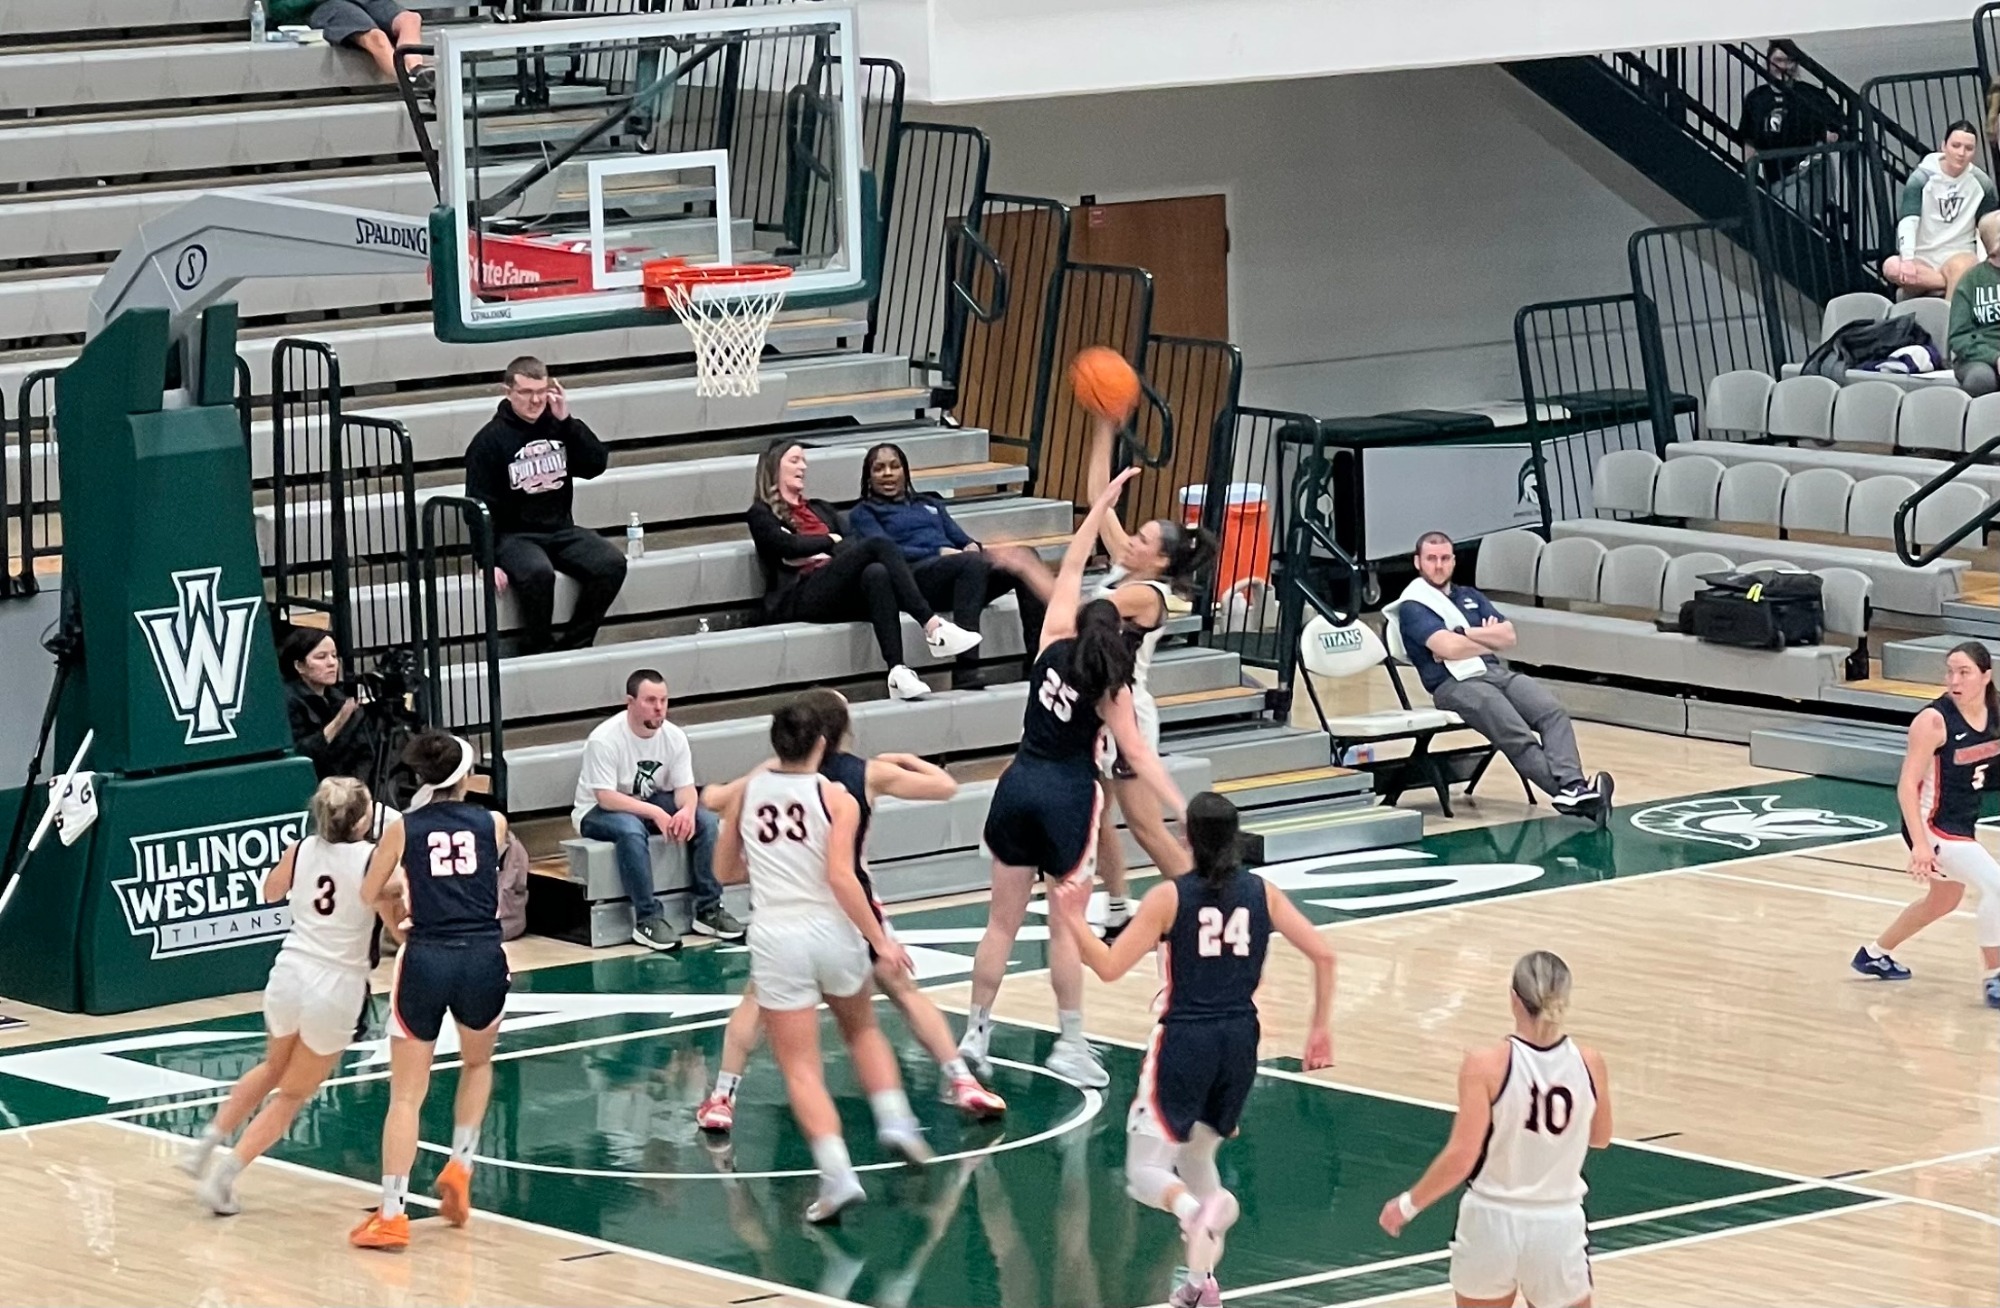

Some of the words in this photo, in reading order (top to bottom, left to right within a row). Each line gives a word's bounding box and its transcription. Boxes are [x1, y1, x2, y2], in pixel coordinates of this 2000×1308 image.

[356, 218, 428, 255] SPALDING
[471, 308, 512, 320] SPALDING
[1319, 629, 1362, 649] TITANS
[1039, 667, 1079, 722] 25
[1971, 764, 1989, 790] 5
[757, 803, 806, 843] 33
[144, 824, 297, 882] ILLINOIS
[427, 830, 477, 876] 23
[314, 875, 335, 916] 3
[172, 912, 282, 943] TITANS
[1198, 906, 1250, 957] 24
[1524, 1081, 1573, 1136] 10
